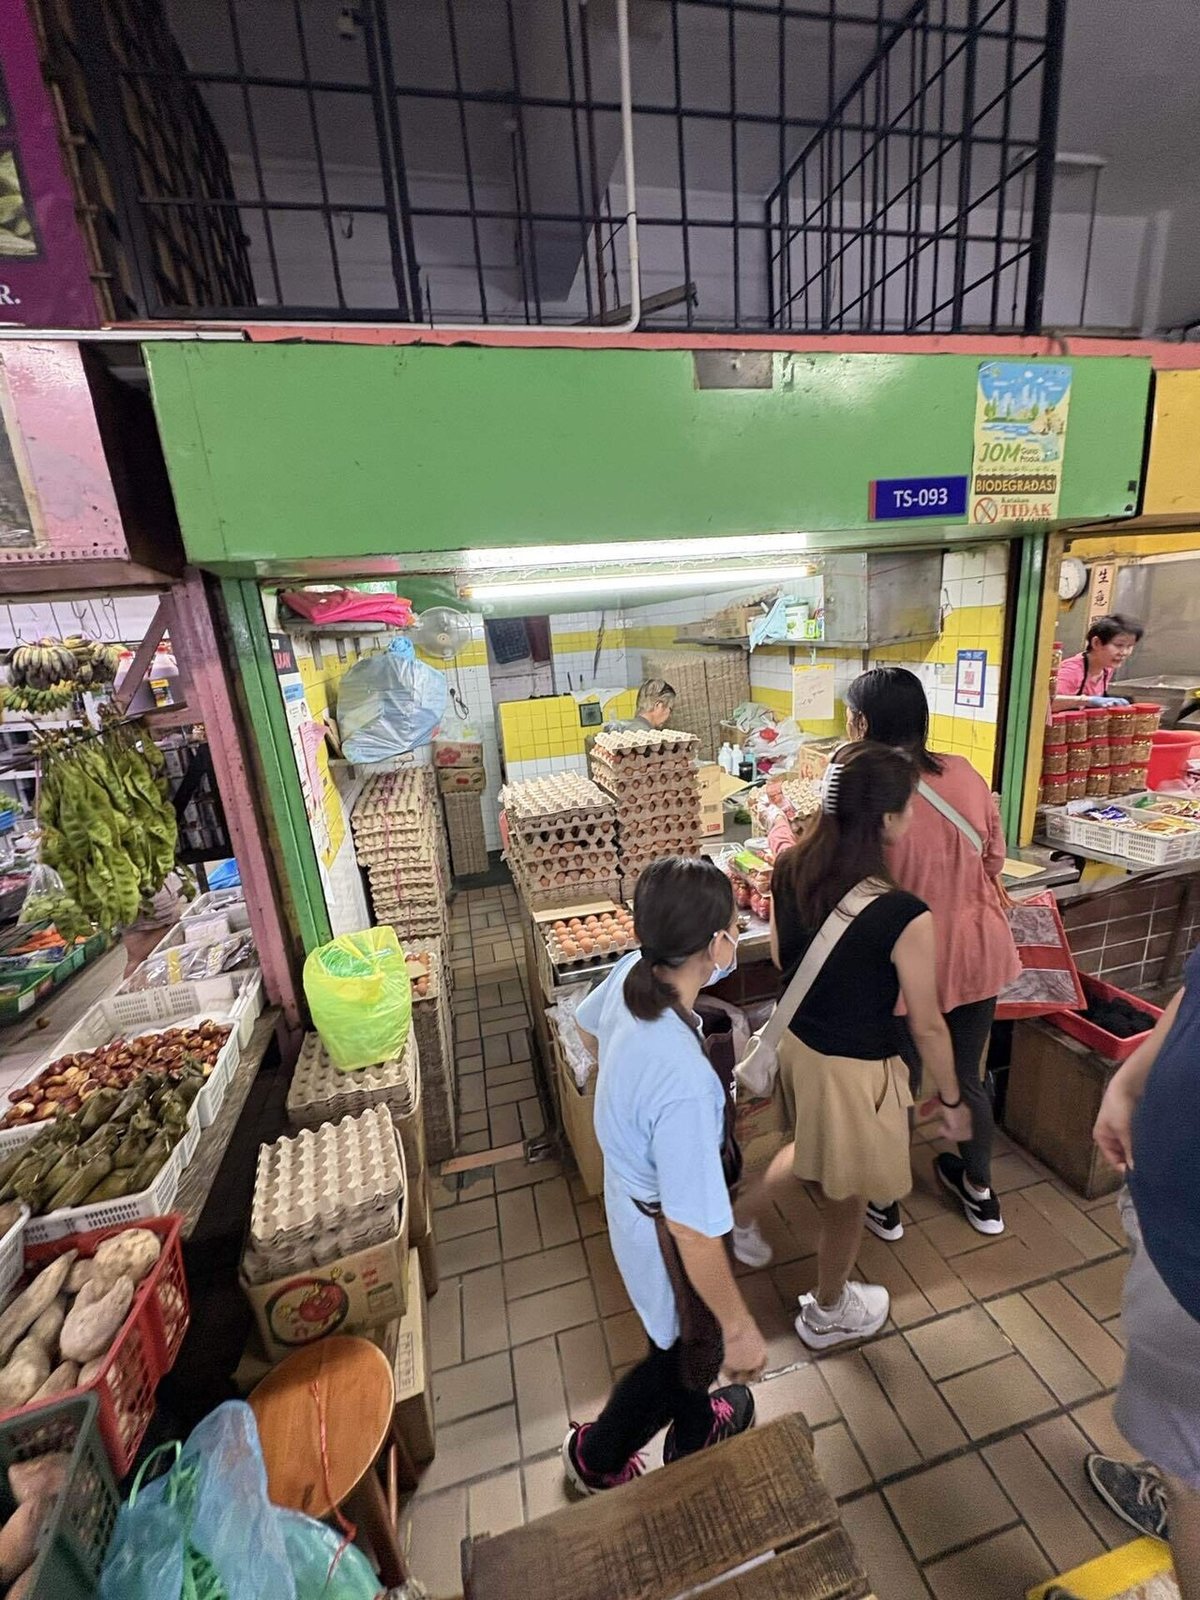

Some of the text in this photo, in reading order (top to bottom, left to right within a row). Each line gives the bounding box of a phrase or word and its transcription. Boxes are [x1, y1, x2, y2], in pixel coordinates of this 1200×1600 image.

[980, 442, 1021, 462] JOM
[976, 479, 1056, 493] BIODEGRADASI
[893, 488, 948, 508] TS-093
[1001, 503, 1052, 517] TIDAK
